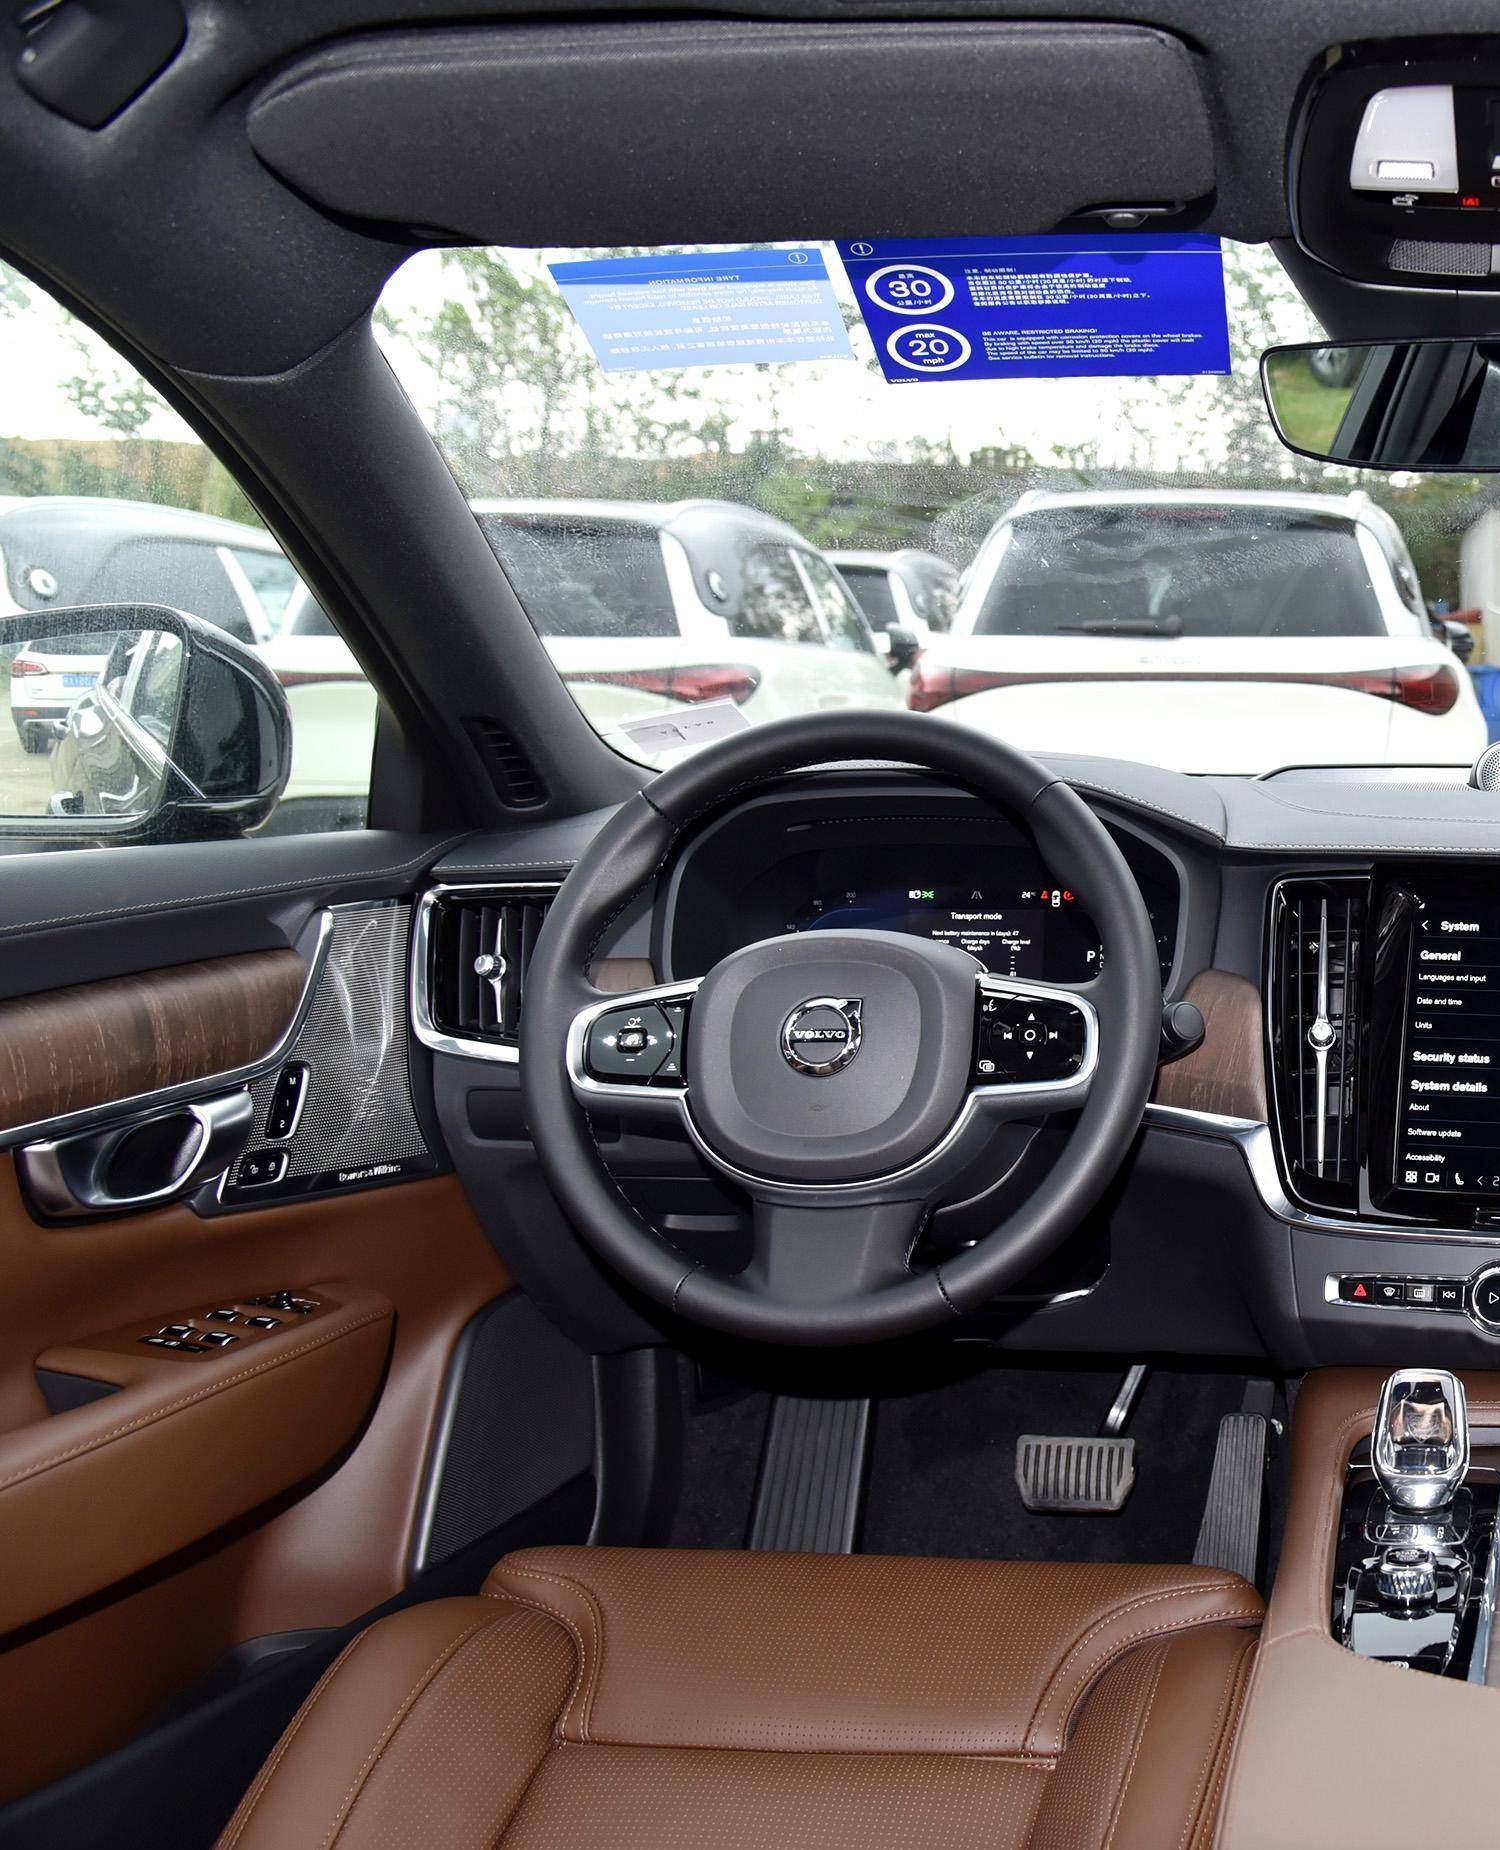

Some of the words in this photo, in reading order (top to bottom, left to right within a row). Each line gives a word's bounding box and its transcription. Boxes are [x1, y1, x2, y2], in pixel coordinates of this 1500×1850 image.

[888, 279, 931, 298] 30
[908, 338, 949, 356] 20
[923, 357, 945, 365] mph
[950, 911, 983, 921] Transport
[983, 912, 1003, 920] mode
[1440, 920, 1480, 933] System
[1086, 950, 1096, 963] P
[1420, 949, 1462, 961] General
[1418, 973, 1455, 983] Languages
[1455, 974, 1469, 982] and
[1469, 974, 1487, 983] input
[1416, 996, 1433, 1005] Date
[1433, 997, 1447, 1005] and
[1447, 998, 1463, 1006] time
[1414, 1021, 1433, 1029] Units
[793, 1030, 846, 1039] VOLVO
[1412, 1051, 1456, 1064] Security
[1457, 1052, 1491, 1064] status
[1410, 1079, 1451, 1092] System
[1451, 1081, 1488, 1093] details
[1408, 1102, 1430, 1111] About
[1407, 1127, 1437, 1137] Software
[1438, 1130, 1462, 1138] update
[1405, 1152, 1446, 1164] Accessibility
